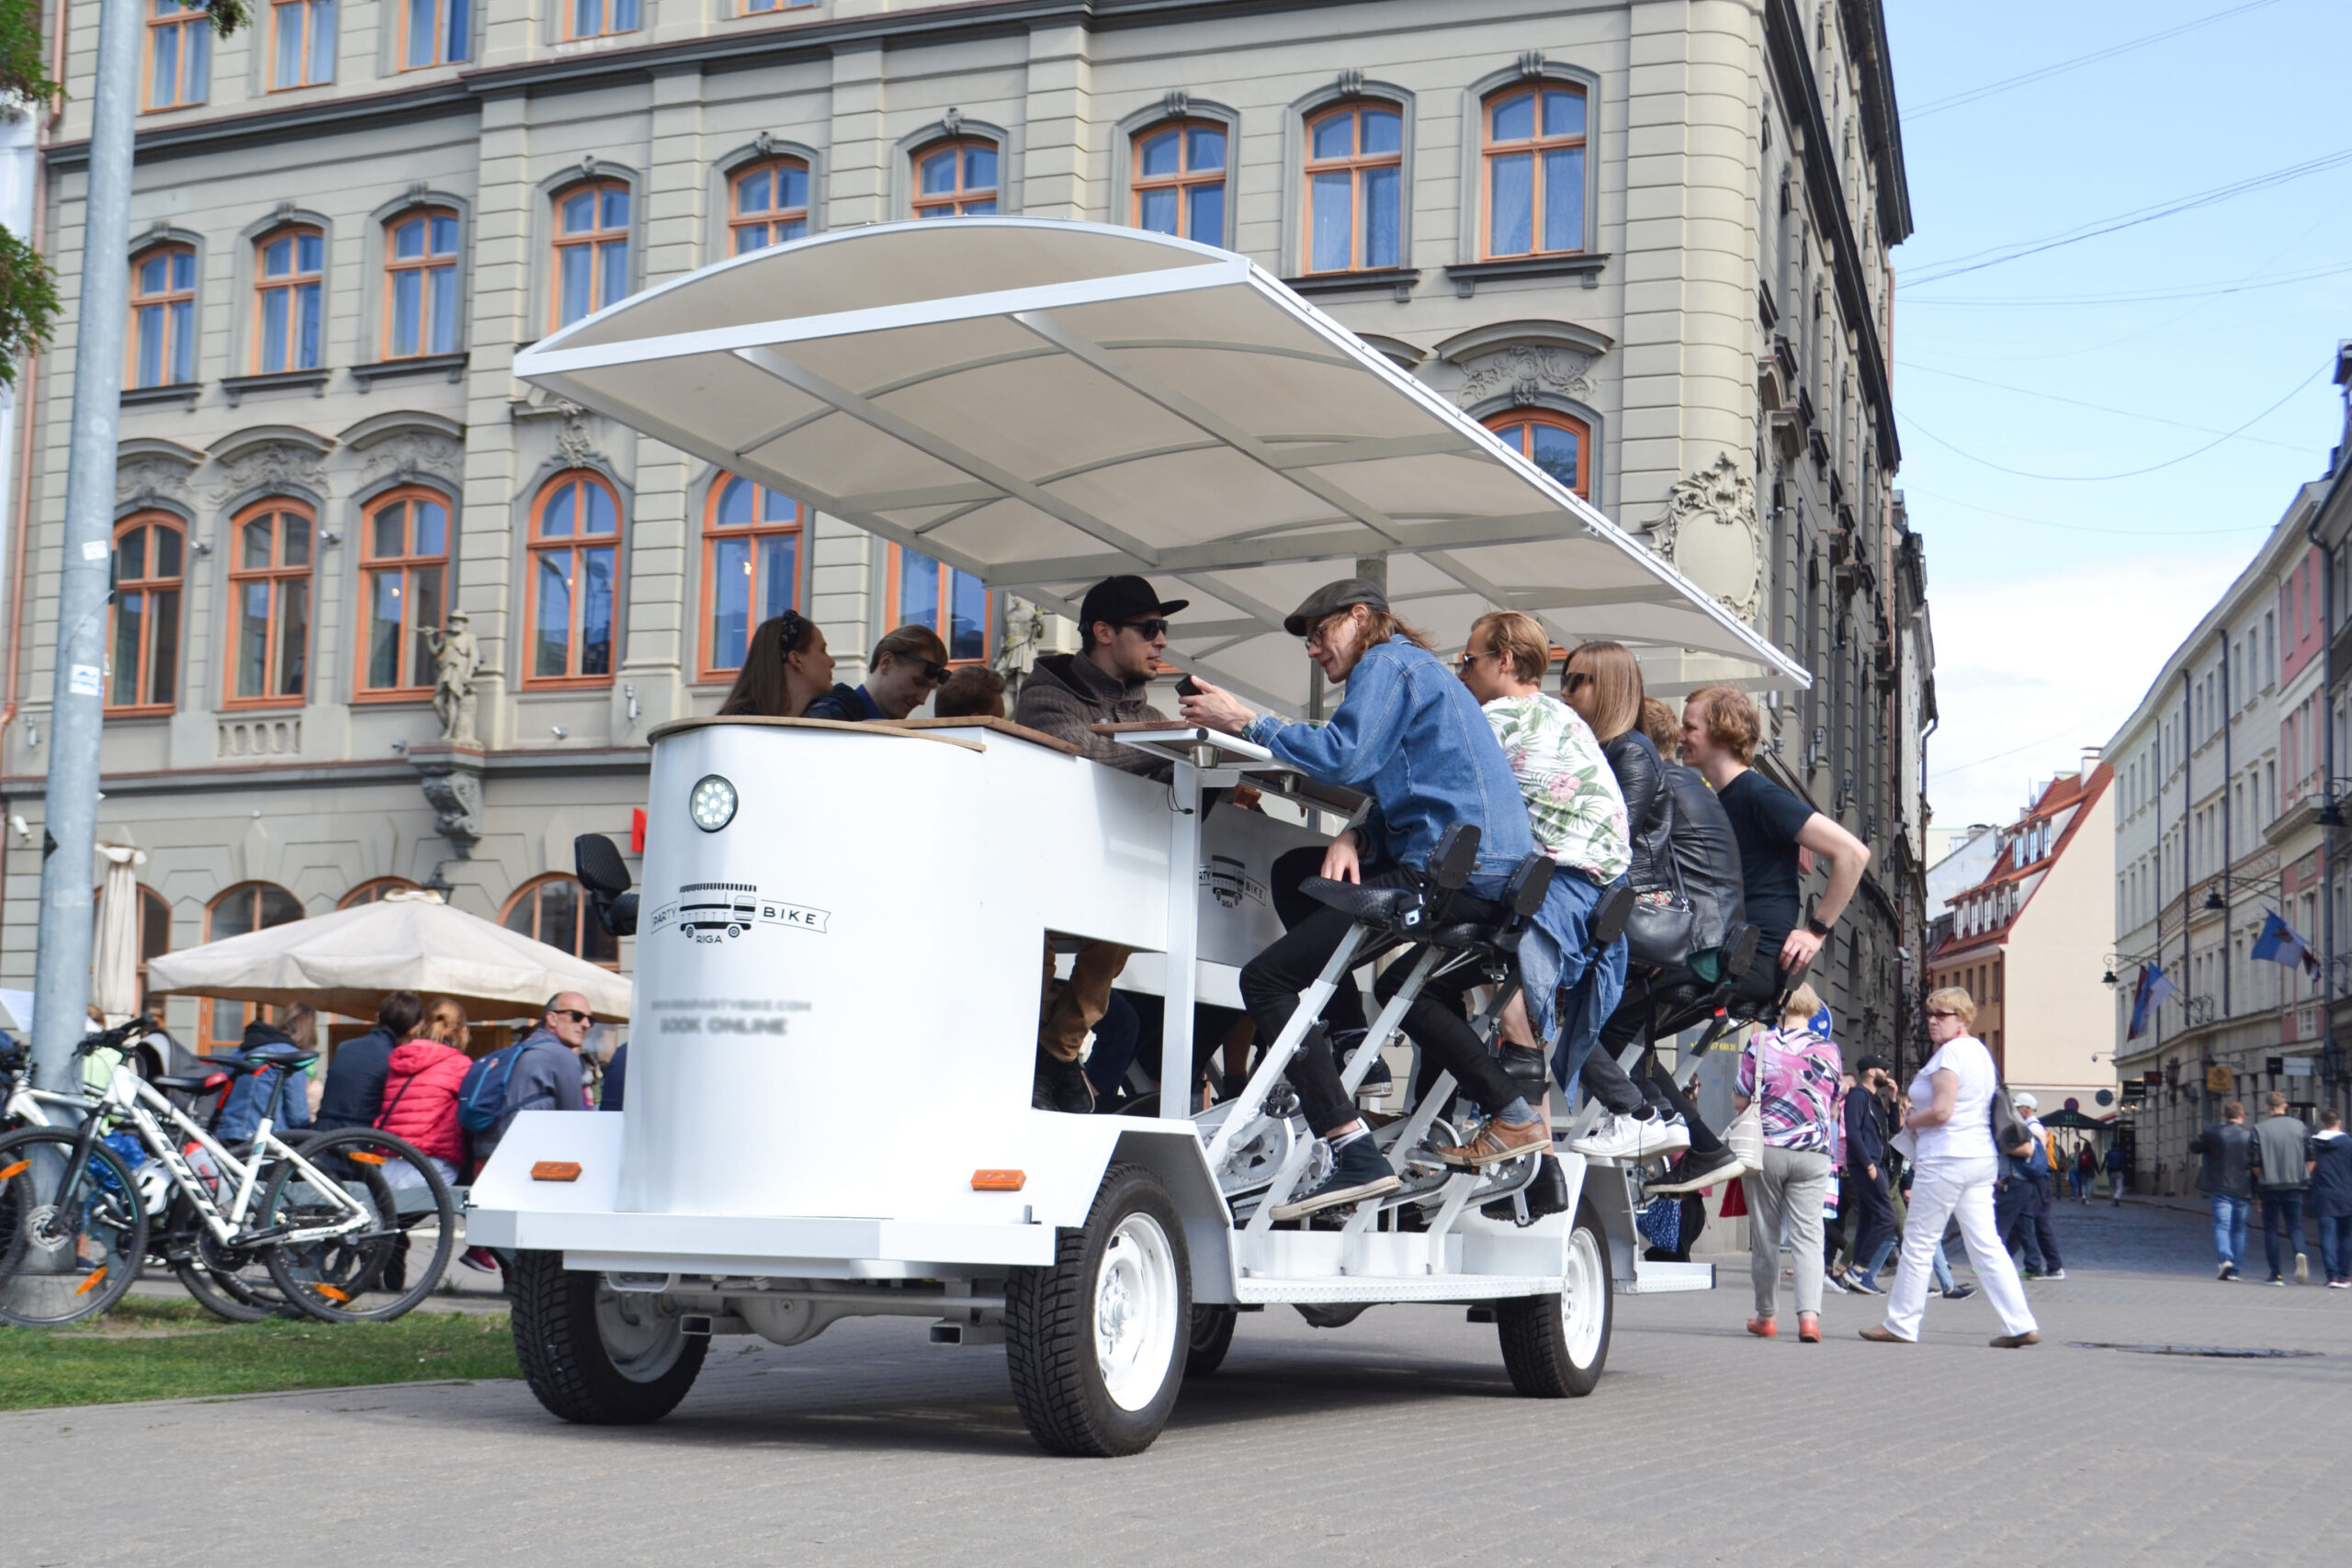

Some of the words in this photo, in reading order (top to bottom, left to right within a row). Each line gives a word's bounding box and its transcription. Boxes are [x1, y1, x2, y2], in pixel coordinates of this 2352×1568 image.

[1246, 882, 1263, 899] BIKE
[653, 908, 677, 926] PARTY
[763, 907, 816, 924] BIKE
[696, 935, 723, 943] RIGA
